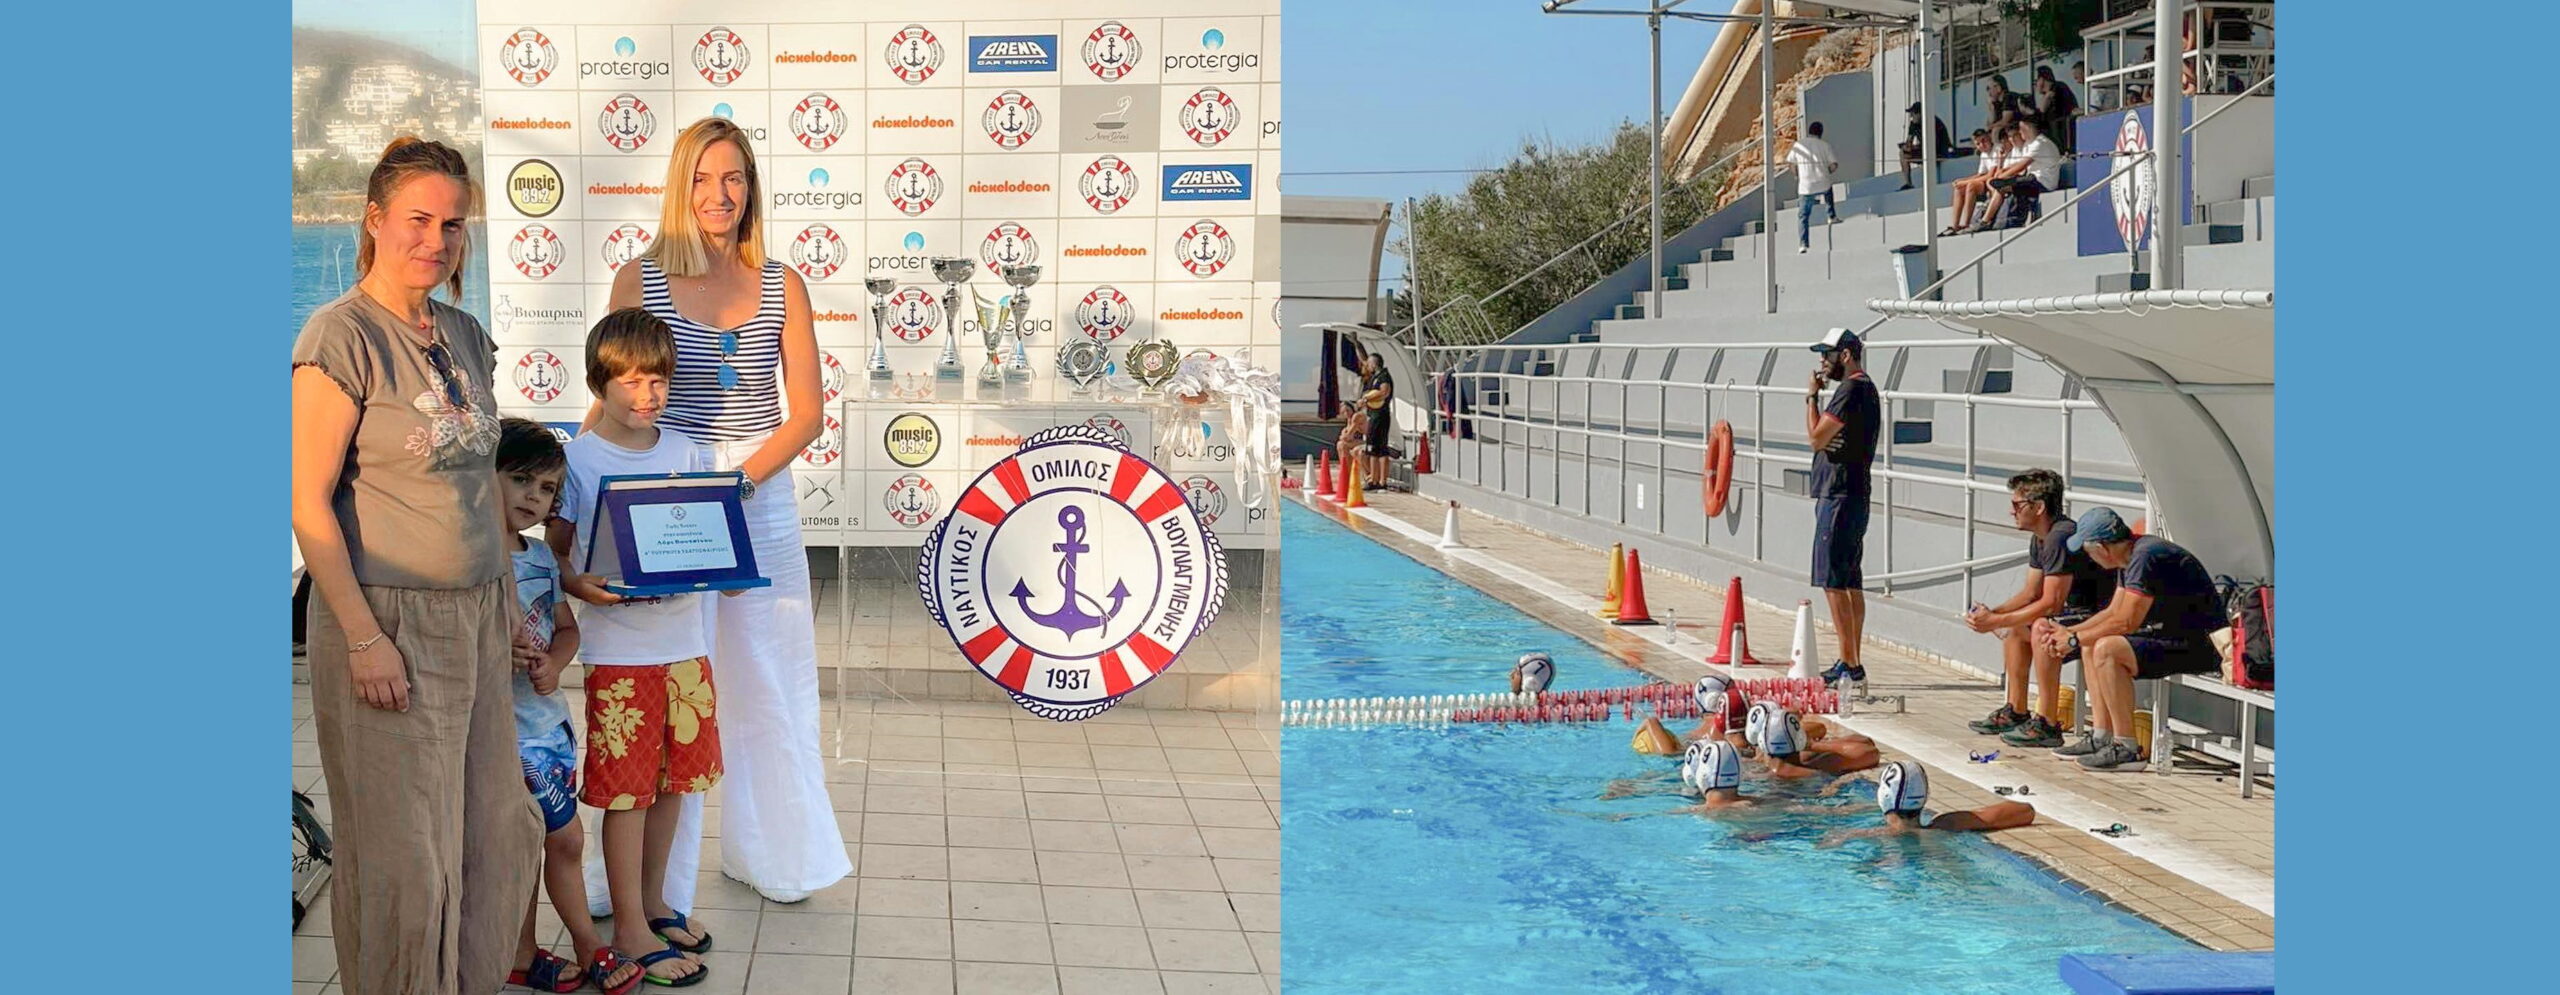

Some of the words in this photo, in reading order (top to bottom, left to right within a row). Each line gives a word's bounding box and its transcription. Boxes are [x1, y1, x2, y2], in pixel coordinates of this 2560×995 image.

[976, 41, 1048, 57] ARENA
[775, 51, 857, 64] nickelodeon
[1003, 58, 1048, 66] RENTAL
[1165, 52, 1258, 73] protergia
[580, 60, 670, 80] protergia
[491, 117, 571, 130] nickelodeon
[872, 115, 954, 129] nickelodeon
[514, 174, 555, 192] music
[968, 180, 1050, 193] nickelodeon
[1170, 170, 1243, 187] ARENA
[521, 188, 550, 204] 89.2
[1197, 187, 1243, 195] RENTAL
[774, 191, 862, 210] protergia
[1064, 243, 1147, 257] nickelodeon
[868, 255, 928, 273] proter
[811, 309, 858, 322] lodeon
[1160, 308, 1243, 320] nickelodeon
[892, 426, 933, 442] music
[966, 434, 1027, 447] nickelod
[899, 440, 928, 454] 89.2
[801, 517, 859, 526] UTOMOBES
[951, 525, 978, 628] ΝΑΥΤΙΚΟΣ
[1031, 458, 1112, 483] ΟΜΙΛΟΣ
[1154, 515, 1193, 643] ΒΟΥΛΙΑΓΜΕΝΗΣ
[1045, 668, 1091, 690] 1937
[1751, 708, 1761, 724] 6
[1789, 716, 1800, 732] 8
[1702, 746, 1712, 764] 9
[1882, 765, 1898, 788] 12
